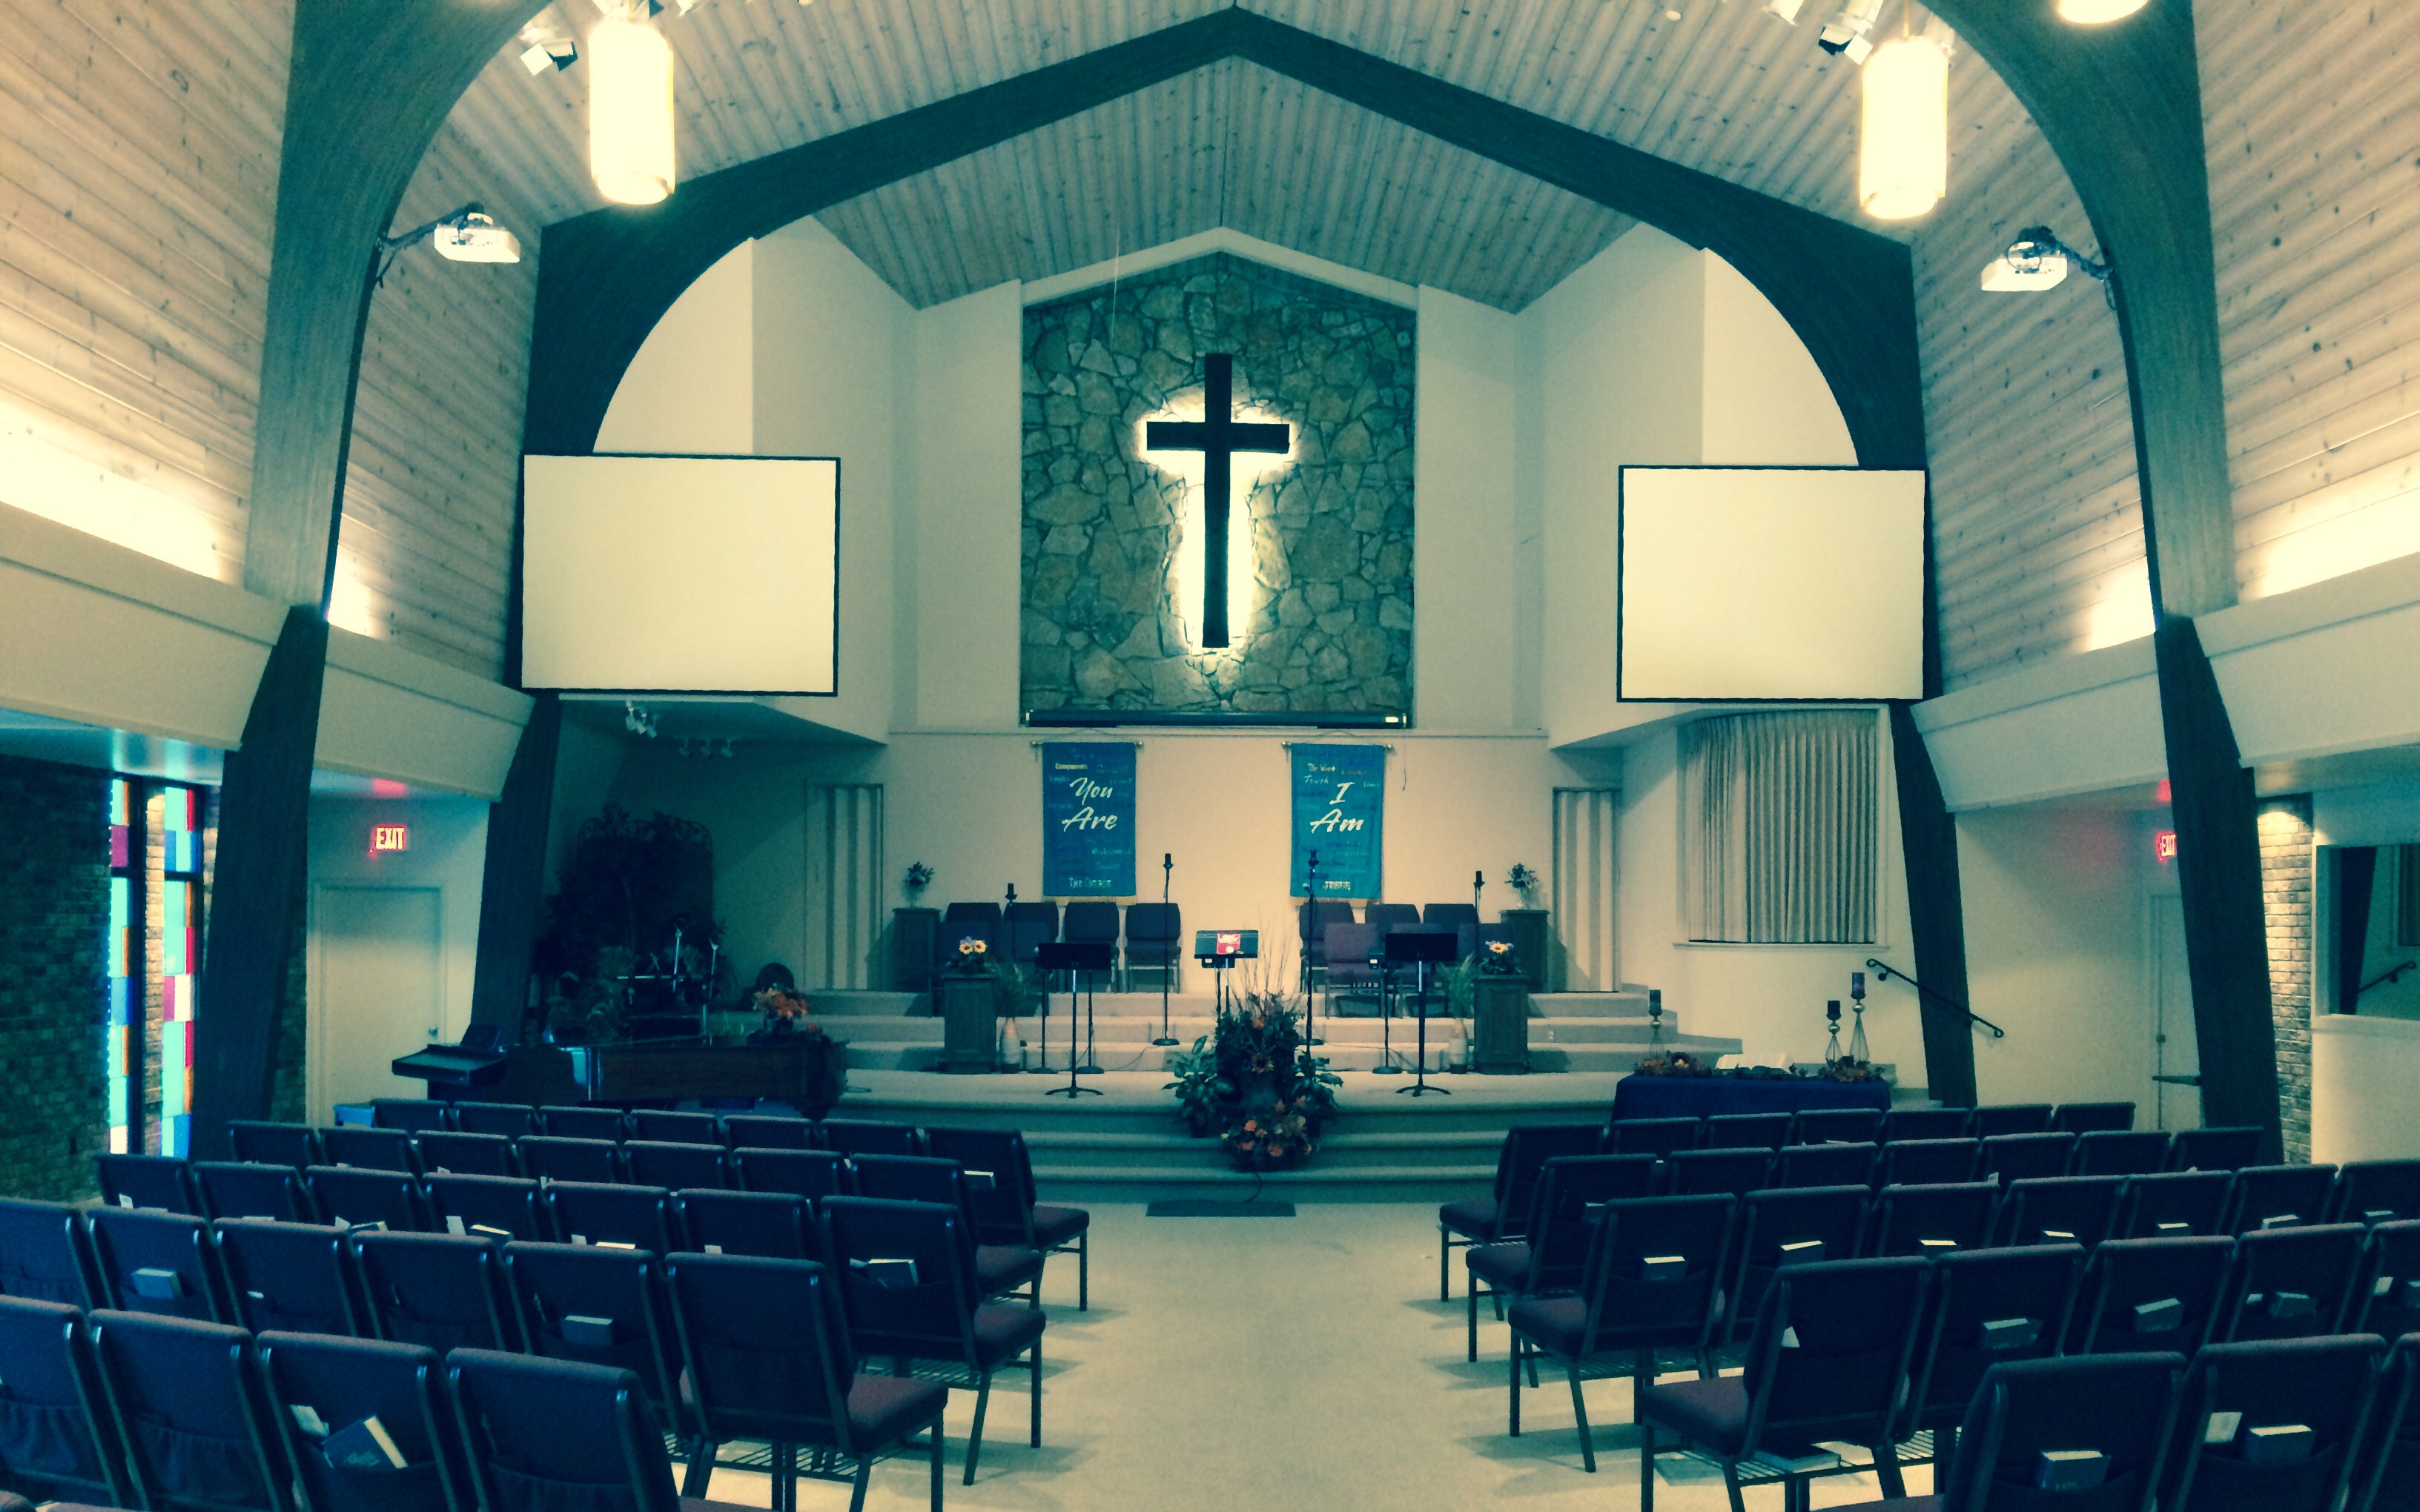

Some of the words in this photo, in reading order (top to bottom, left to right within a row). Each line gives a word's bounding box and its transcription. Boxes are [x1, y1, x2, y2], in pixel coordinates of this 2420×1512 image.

[1069, 777, 1113, 806] You
[1329, 782, 1355, 805] I
[1062, 806, 1118, 832] Are
[1309, 808, 1364, 834] Am
[375, 827, 405, 850] EXIT
